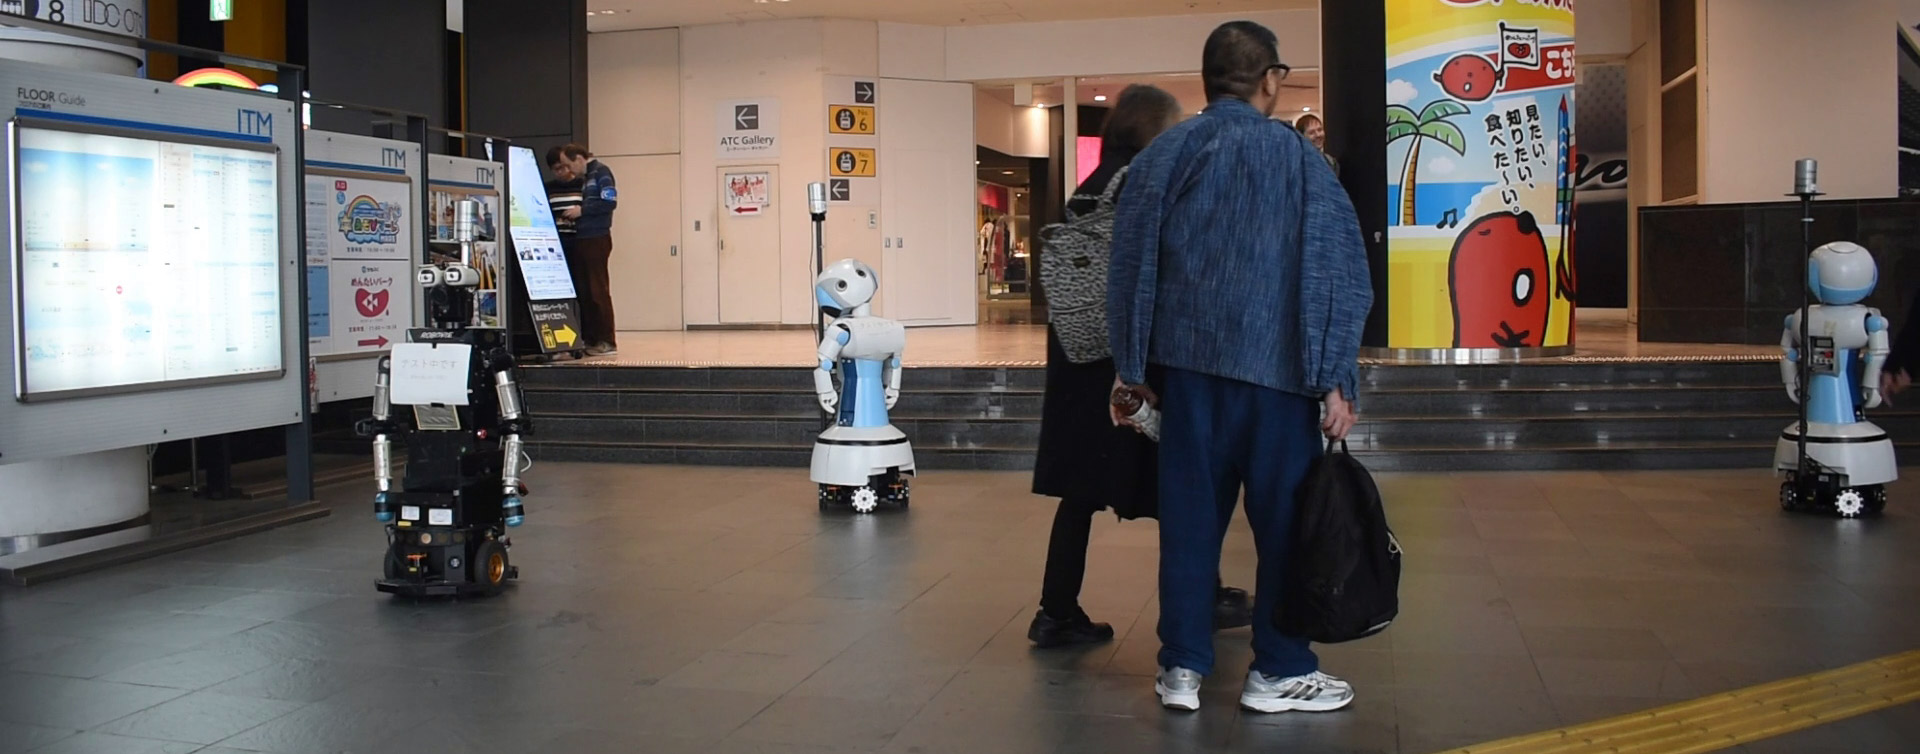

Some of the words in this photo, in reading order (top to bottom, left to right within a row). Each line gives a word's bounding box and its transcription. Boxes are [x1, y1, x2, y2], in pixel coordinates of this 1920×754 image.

[49, 0, 64, 24] 8
[1545, 48, 1575, 79] こち
[17, 87, 55, 102] FLOOR
[58, 92, 86, 106] Guide
[238, 109, 272, 136] ITM
[859, 117, 868, 131] 6
[721, 136, 740, 145] ATC
[742, 135, 775, 146] Gallery
[1525, 104, 1547, 166] 見たい、
[382, 147, 406, 168] ITM
[1506, 109, 1534, 188] 知りたい、
[476, 166, 495, 184] ITM
[860, 160, 868, 173] 7
